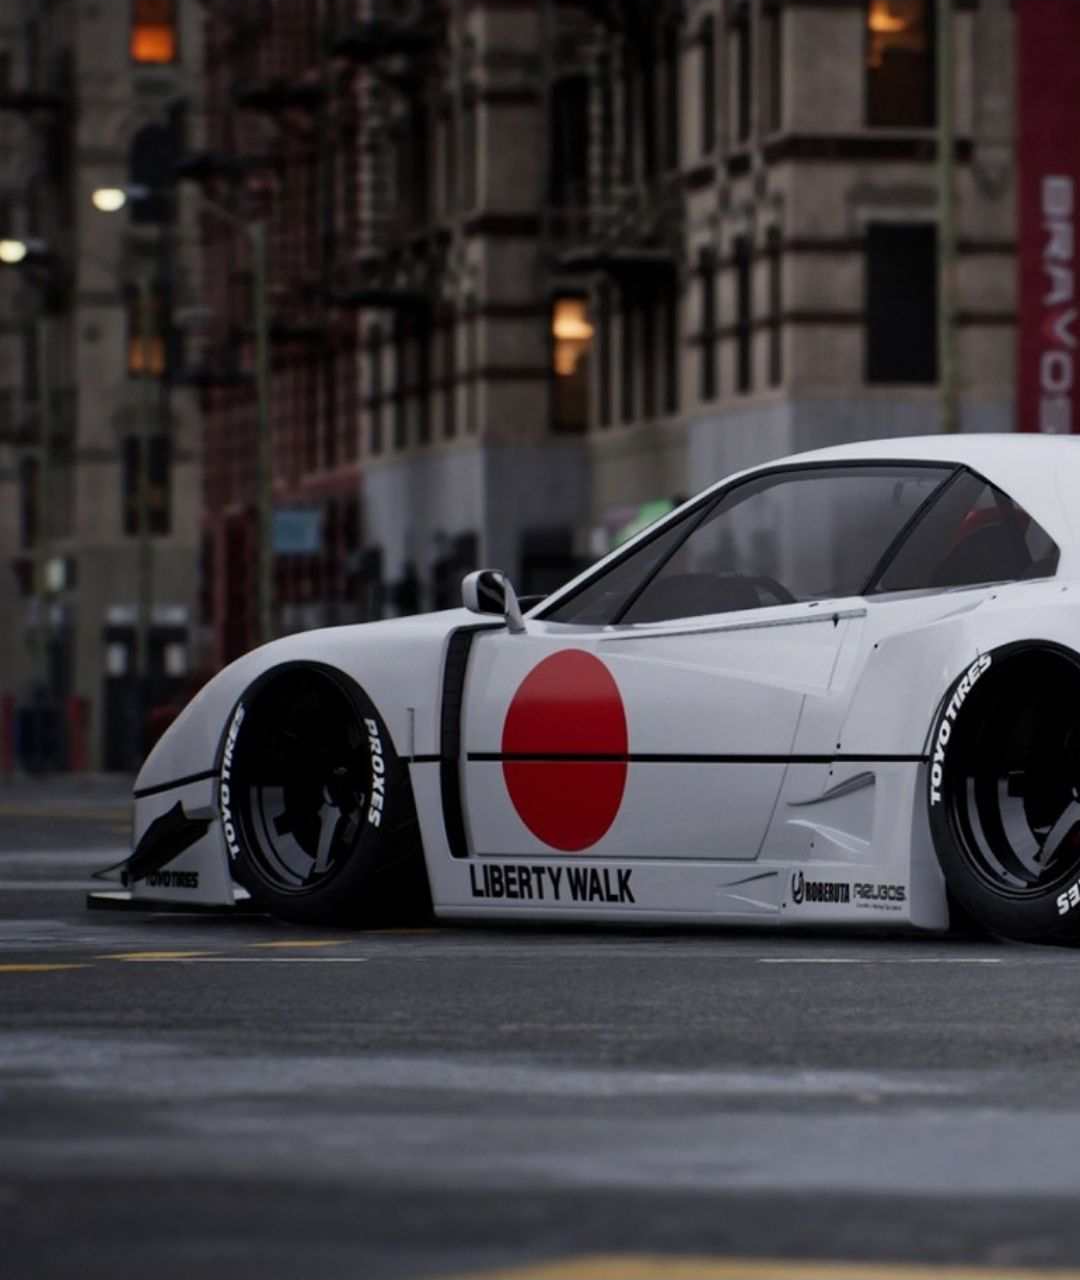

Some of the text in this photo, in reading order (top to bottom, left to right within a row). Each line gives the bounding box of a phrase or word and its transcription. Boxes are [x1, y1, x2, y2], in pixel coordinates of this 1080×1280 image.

[364, 718, 385, 828] PROXES
[469, 864, 636, 903] LIBERTY WALK
[805, 881, 850, 903] ROBERUTA
